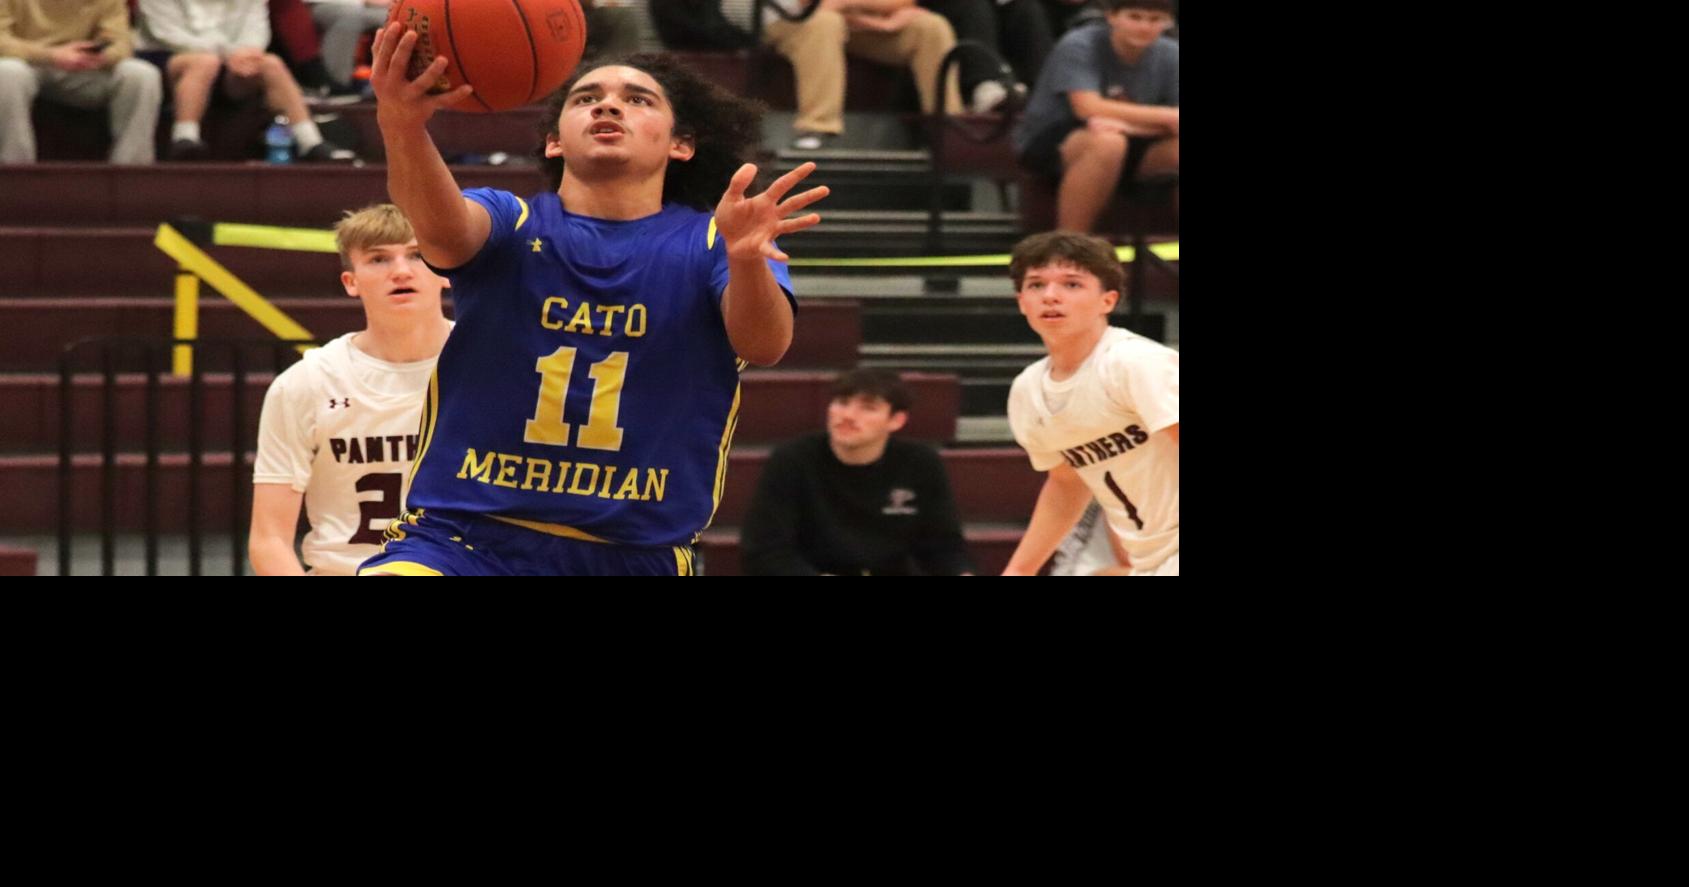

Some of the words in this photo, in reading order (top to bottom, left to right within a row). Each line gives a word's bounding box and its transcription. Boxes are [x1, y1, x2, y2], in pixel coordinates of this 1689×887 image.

[541, 296, 647, 337] CATO
[524, 346, 629, 451] 11
[456, 448, 669, 502] MERIDIAN
[1104, 470, 1144, 530] 1
[349, 472, 402, 545] 2
